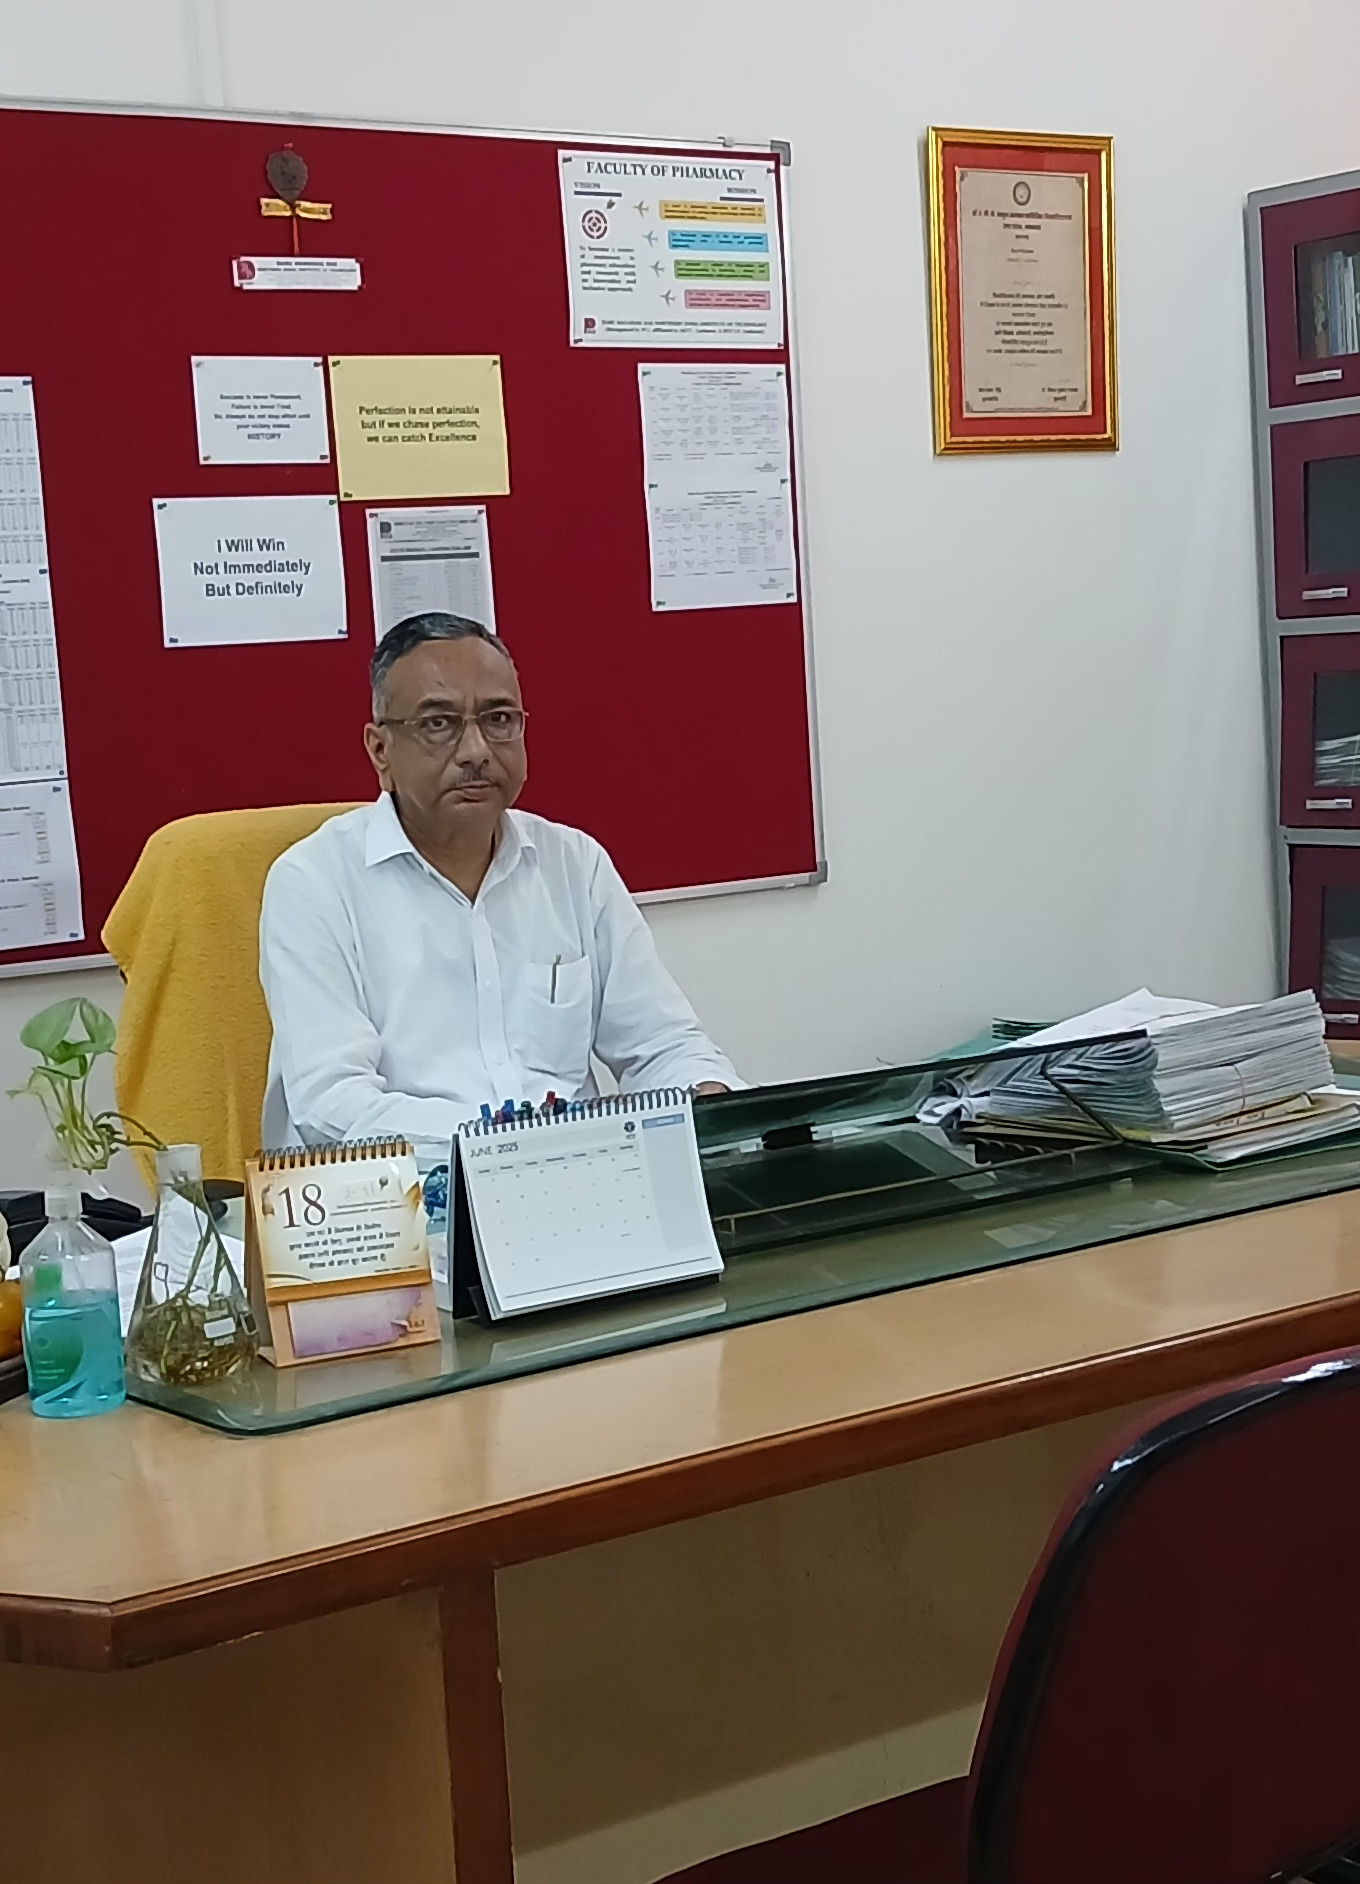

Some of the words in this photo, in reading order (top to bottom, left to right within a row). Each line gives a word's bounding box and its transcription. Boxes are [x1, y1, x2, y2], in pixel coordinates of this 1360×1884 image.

[586, 161, 649, 176] FACULTY
[650, 164, 669, 177] OF
[671, 165, 746, 181] PHARMACY
[358, 405, 407, 415] Perfection
[408, 405, 417, 415] is
[418, 406, 435, 415] not
[436, 405, 480, 415] attainable
[360, 419, 377, 429] but
[378, 419, 386, 429] if
[386, 421, 401, 429] we
[366, 435, 380, 443] we
[381, 435, 400, 443] can
[400, 432, 427, 443] catch
[428, 432, 477, 443] Excellence
[216, 538, 223, 554] I
[224, 537, 254, 553] Will
[256, 537, 286, 552] Win
[192, 561, 221, 576] Not
[223, 558, 312, 576] Immediately
[204, 583, 233, 598] But
[234, 579, 304, 598] Definitely
[469, 1145, 493, 1159] JUNE
[496, 1141, 519, 1155] 2025
[277, 1183, 327, 1230] 18
